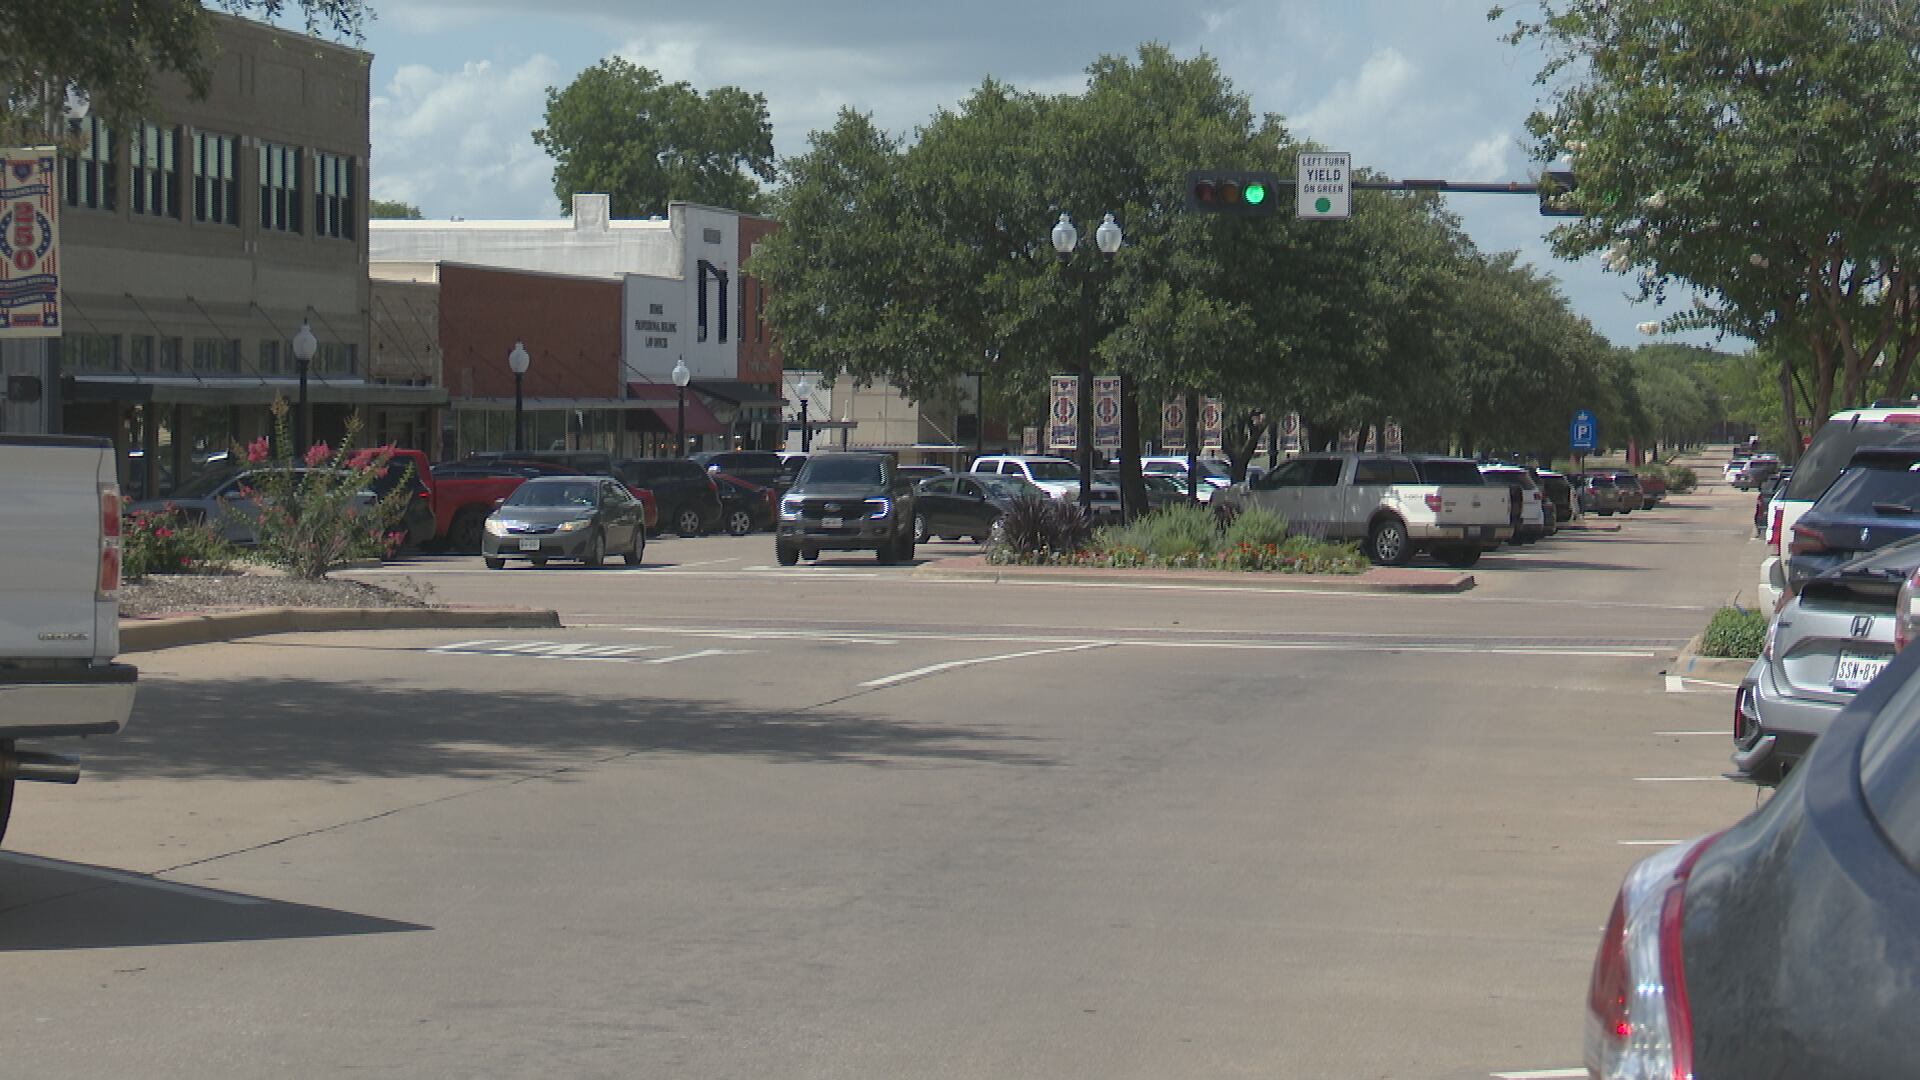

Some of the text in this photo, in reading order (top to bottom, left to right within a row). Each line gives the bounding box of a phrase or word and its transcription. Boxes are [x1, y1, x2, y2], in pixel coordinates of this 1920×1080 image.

[1302, 157, 1346, 167] LEFT TURN
[1307, 169, 1341, 181] YIELD
[1304, 183, 1344, 193] ON GREEN
[1578, 425, 1588, 440] P
